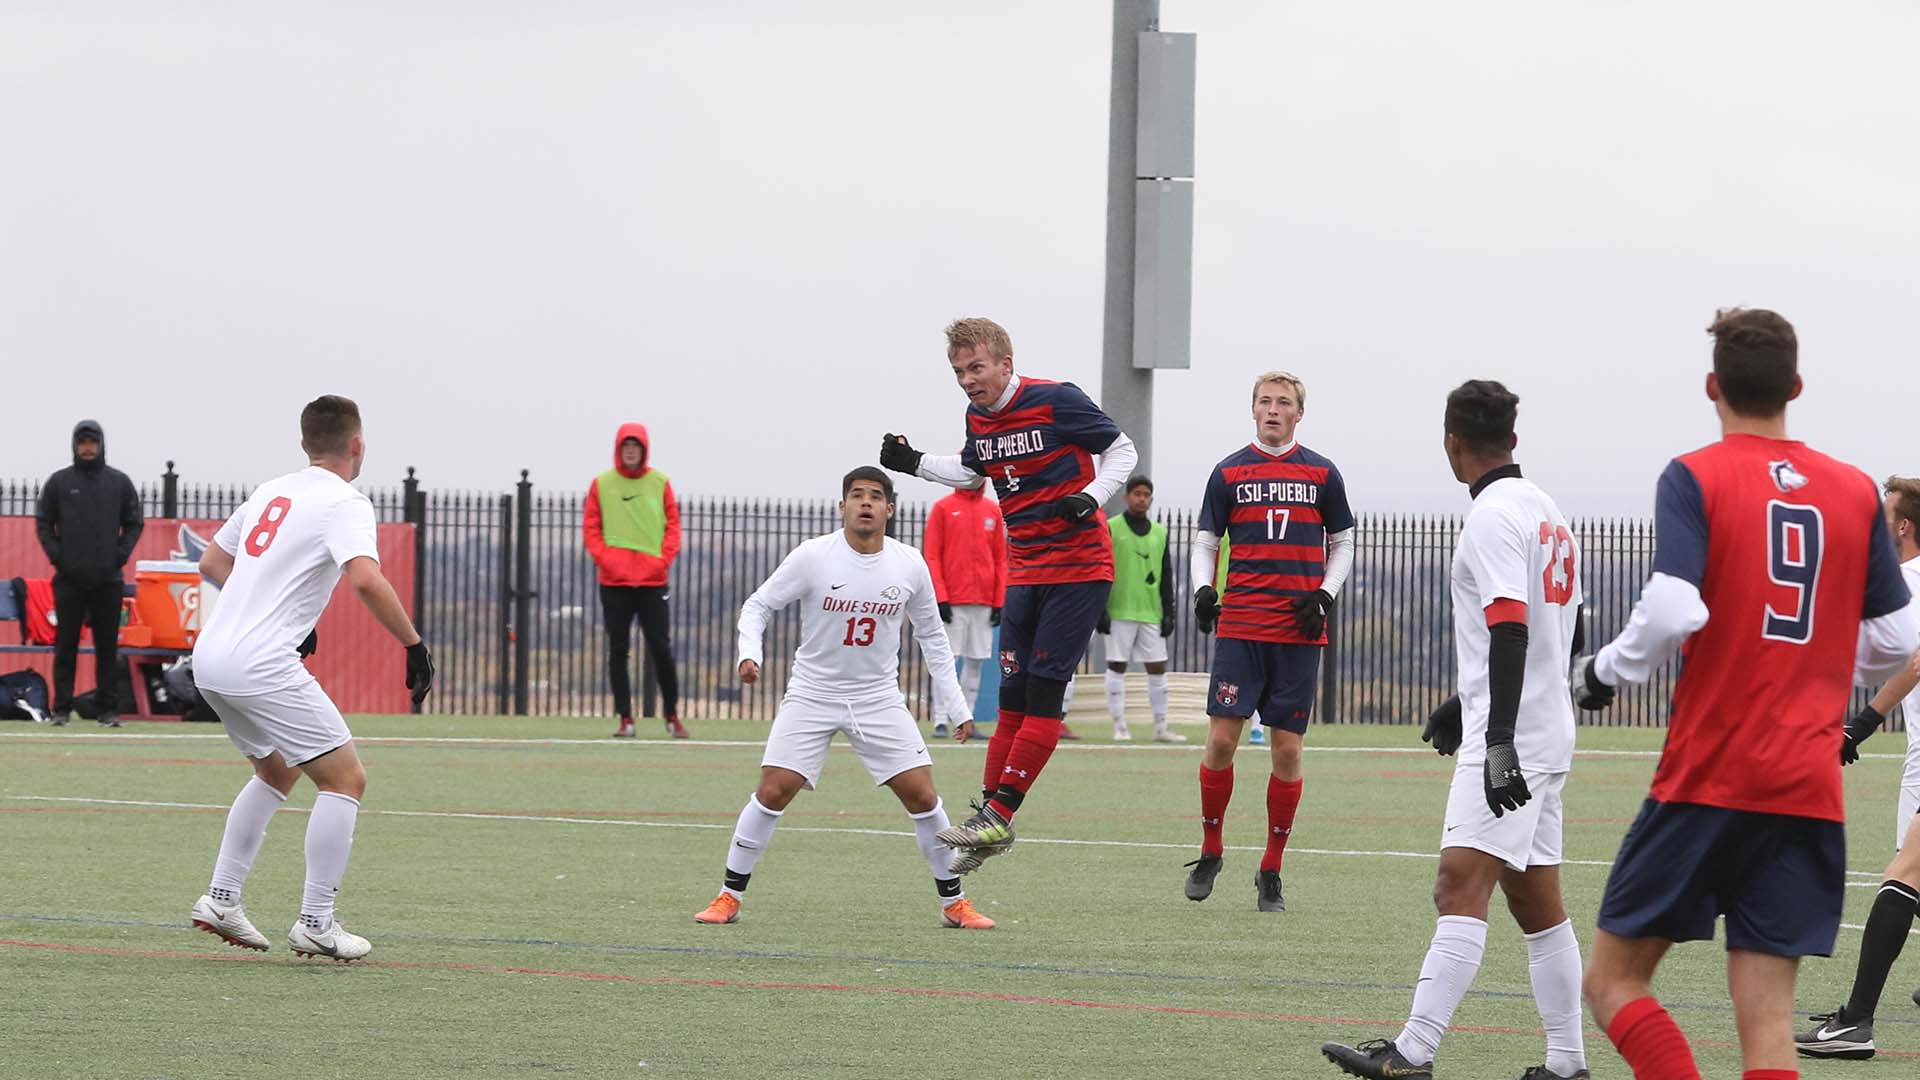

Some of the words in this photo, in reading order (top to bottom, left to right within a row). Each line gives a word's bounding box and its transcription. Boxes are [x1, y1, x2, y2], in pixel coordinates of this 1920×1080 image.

[976, 430, 1044, 461] CSU-PUEBLO
[1236, 482, 1317, 504] CSU-PUEBLO
[245, 496, 292, 557] 8
[1266, 509, 1290, 540] 17
[1539, 521, 1575, 606] 23
[1762, 499, 1825, 644] 9
[822, 596, 859, 613] DIXIE
[860, 601, 903, 616] STATE
[843, 616, 877, 647] 13
